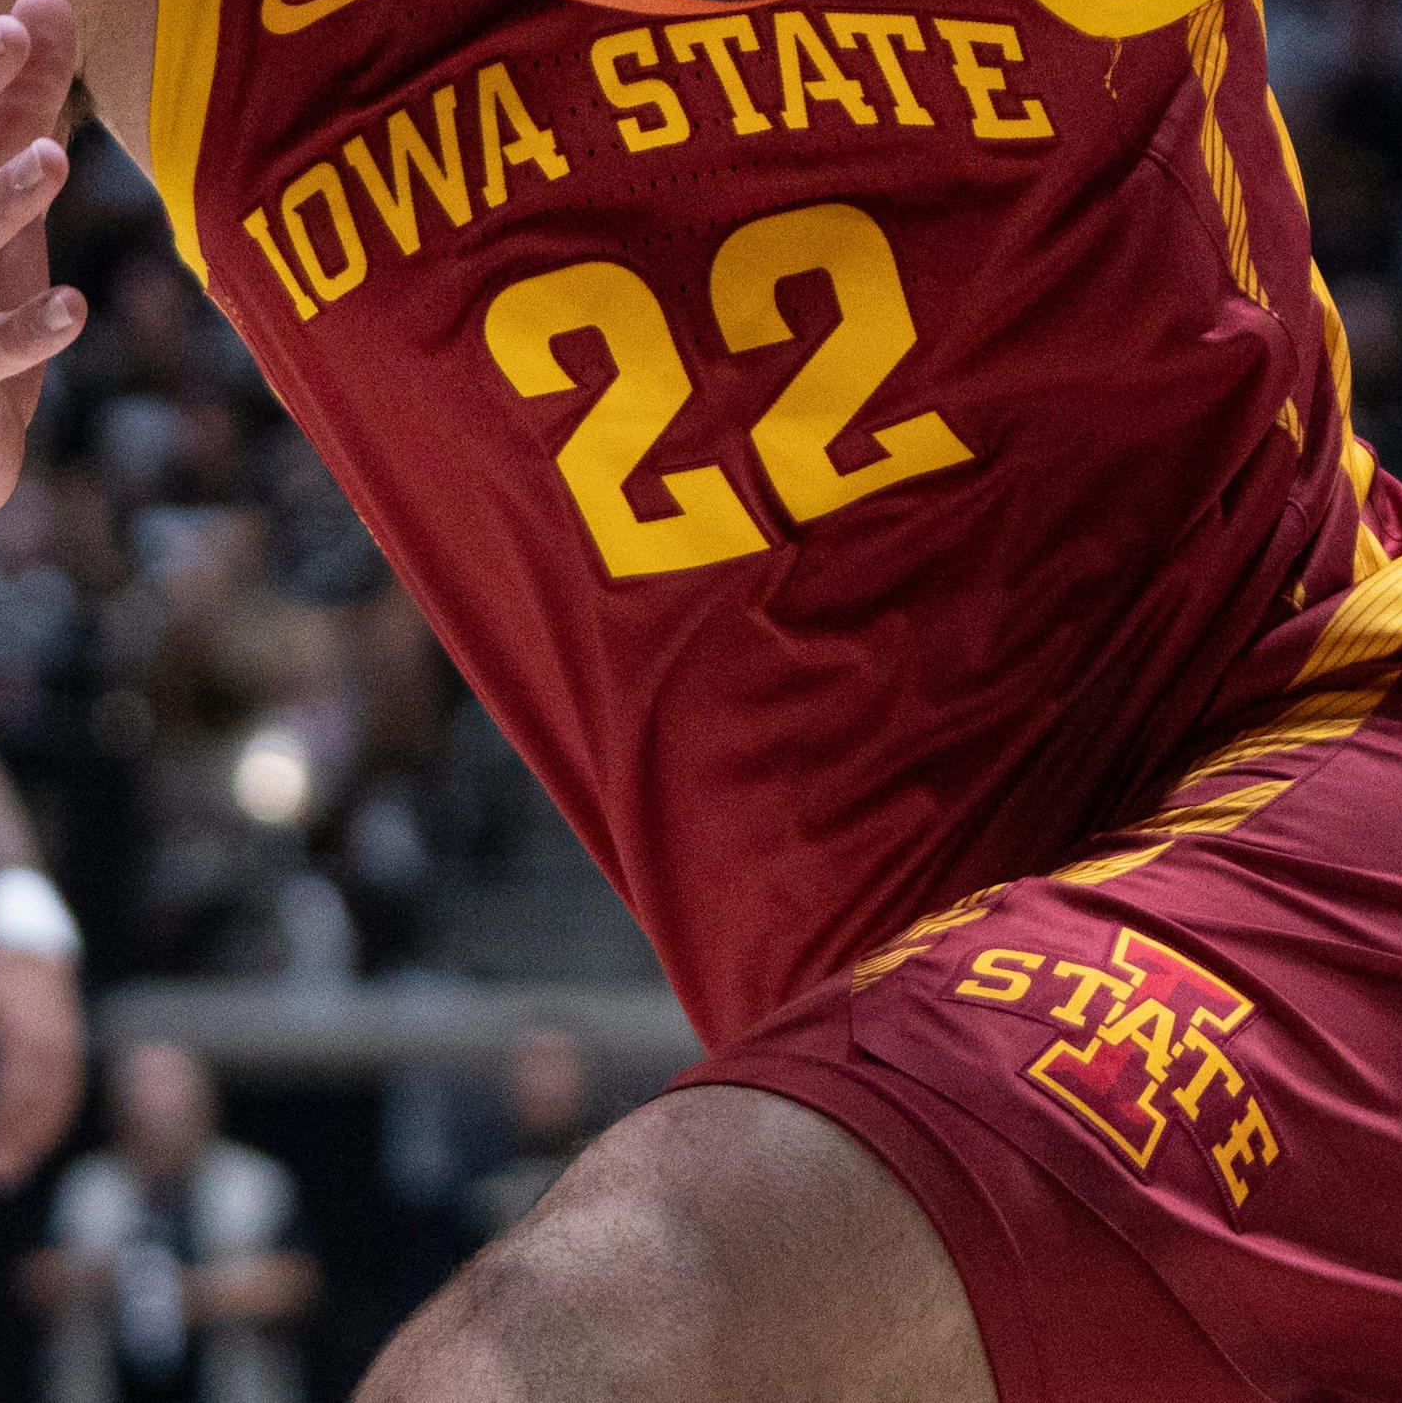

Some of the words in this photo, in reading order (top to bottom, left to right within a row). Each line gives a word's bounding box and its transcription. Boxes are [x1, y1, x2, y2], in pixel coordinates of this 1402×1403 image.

[244, 63, 570, 323] IOWA
[590, 10, 1055, 153] STATE
[483, 202, 975, 579] 22
[955, 947, 1279, 1207] STATE
